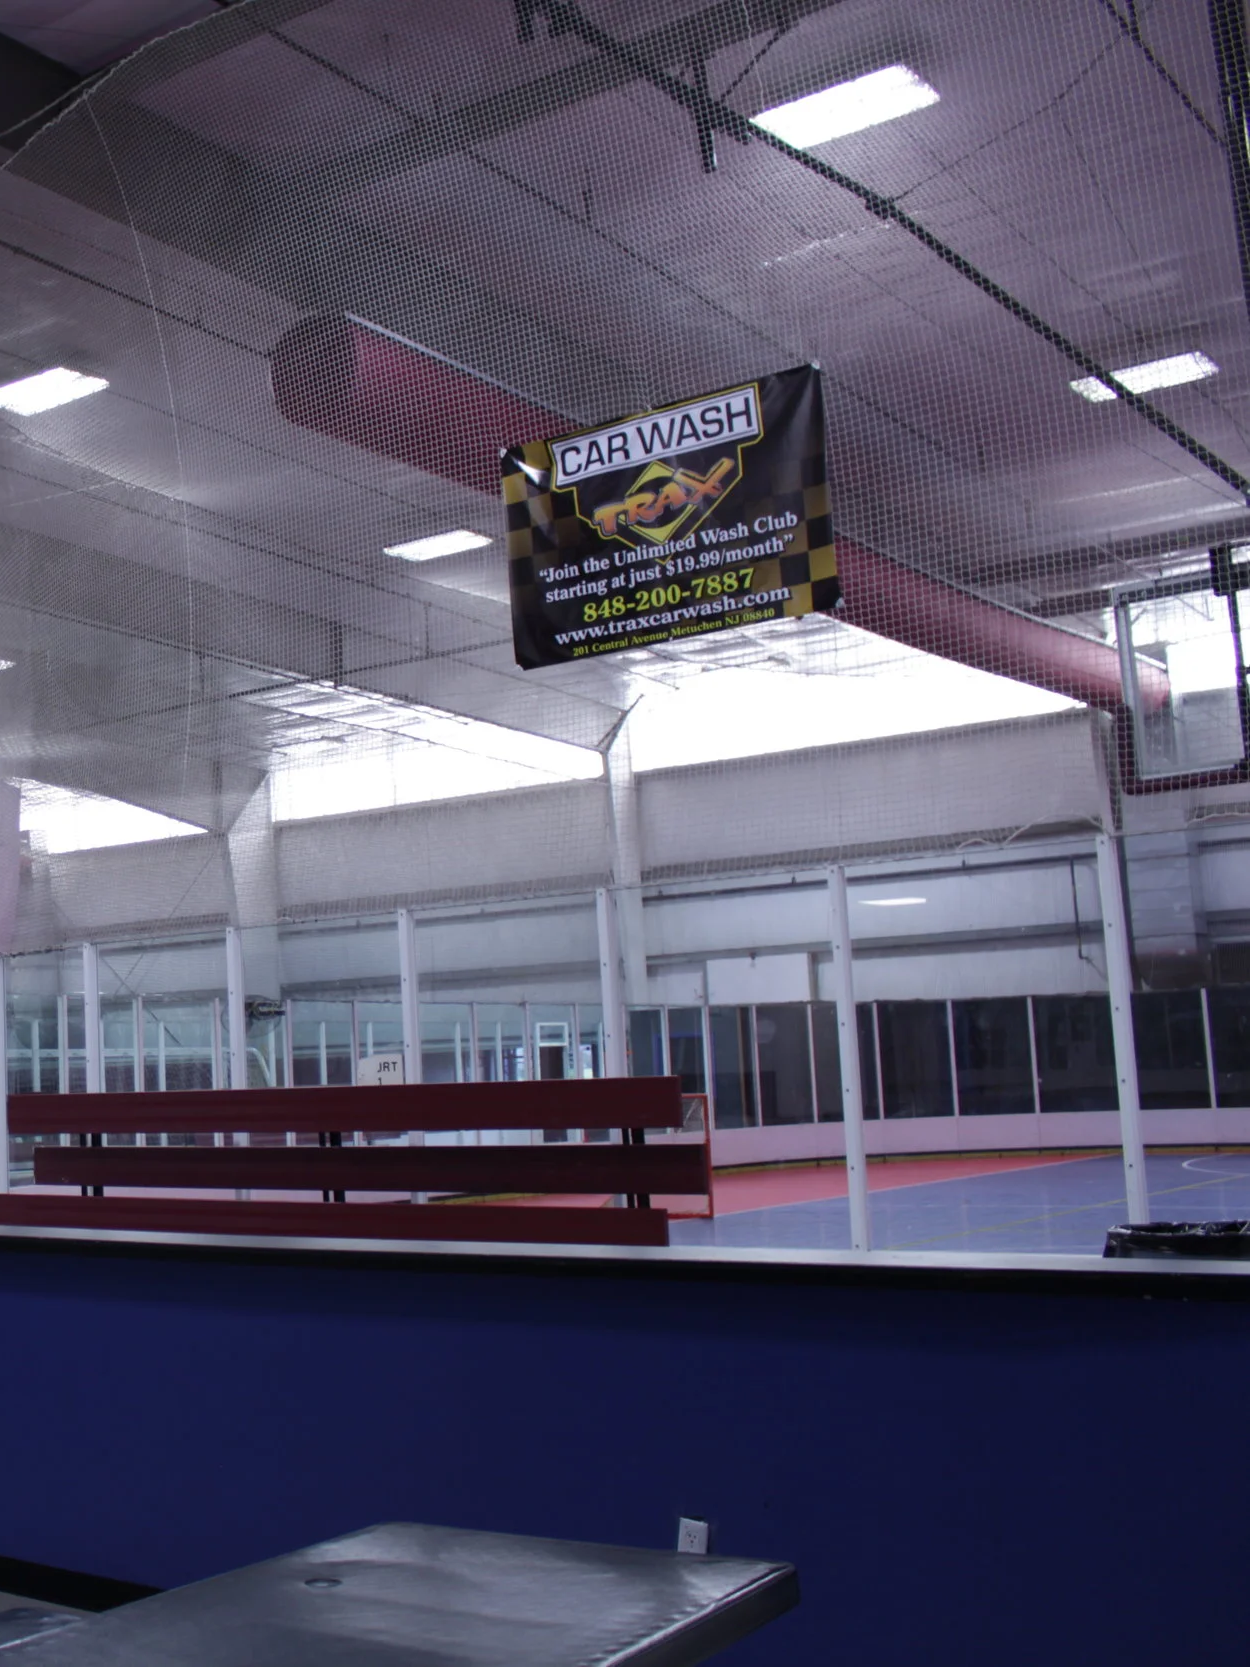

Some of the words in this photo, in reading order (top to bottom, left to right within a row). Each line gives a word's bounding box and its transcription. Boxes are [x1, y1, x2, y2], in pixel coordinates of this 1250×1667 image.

[560, 431, 630, 477] CAR
[636, 397, 753, 455] WASH
[593, 457, 735, 535] TRAX
[583, 556, 610, 574] the
[613, 535, 697, 567] Unlimited
[699, 521, 749, 546] Wash
[753, 511, 799, 534] Club
[545, 578, 608, 603] starting
[610, 572, 627, 588] at
[628, 565, 662, 588] just
[582, 567, 755, 623] 848-200-7887
[554, 586, 792, 646] www.traxcarwash.com
[572, 645, 590, 657] 201
[591, 638, 629, 654] Central
[631, 630, 669, 646] Avenue
[670, 619, 723, 638] Metuchen
[724, 614, 741, 625] NJ
[742, 608, 775, 623] 08840
